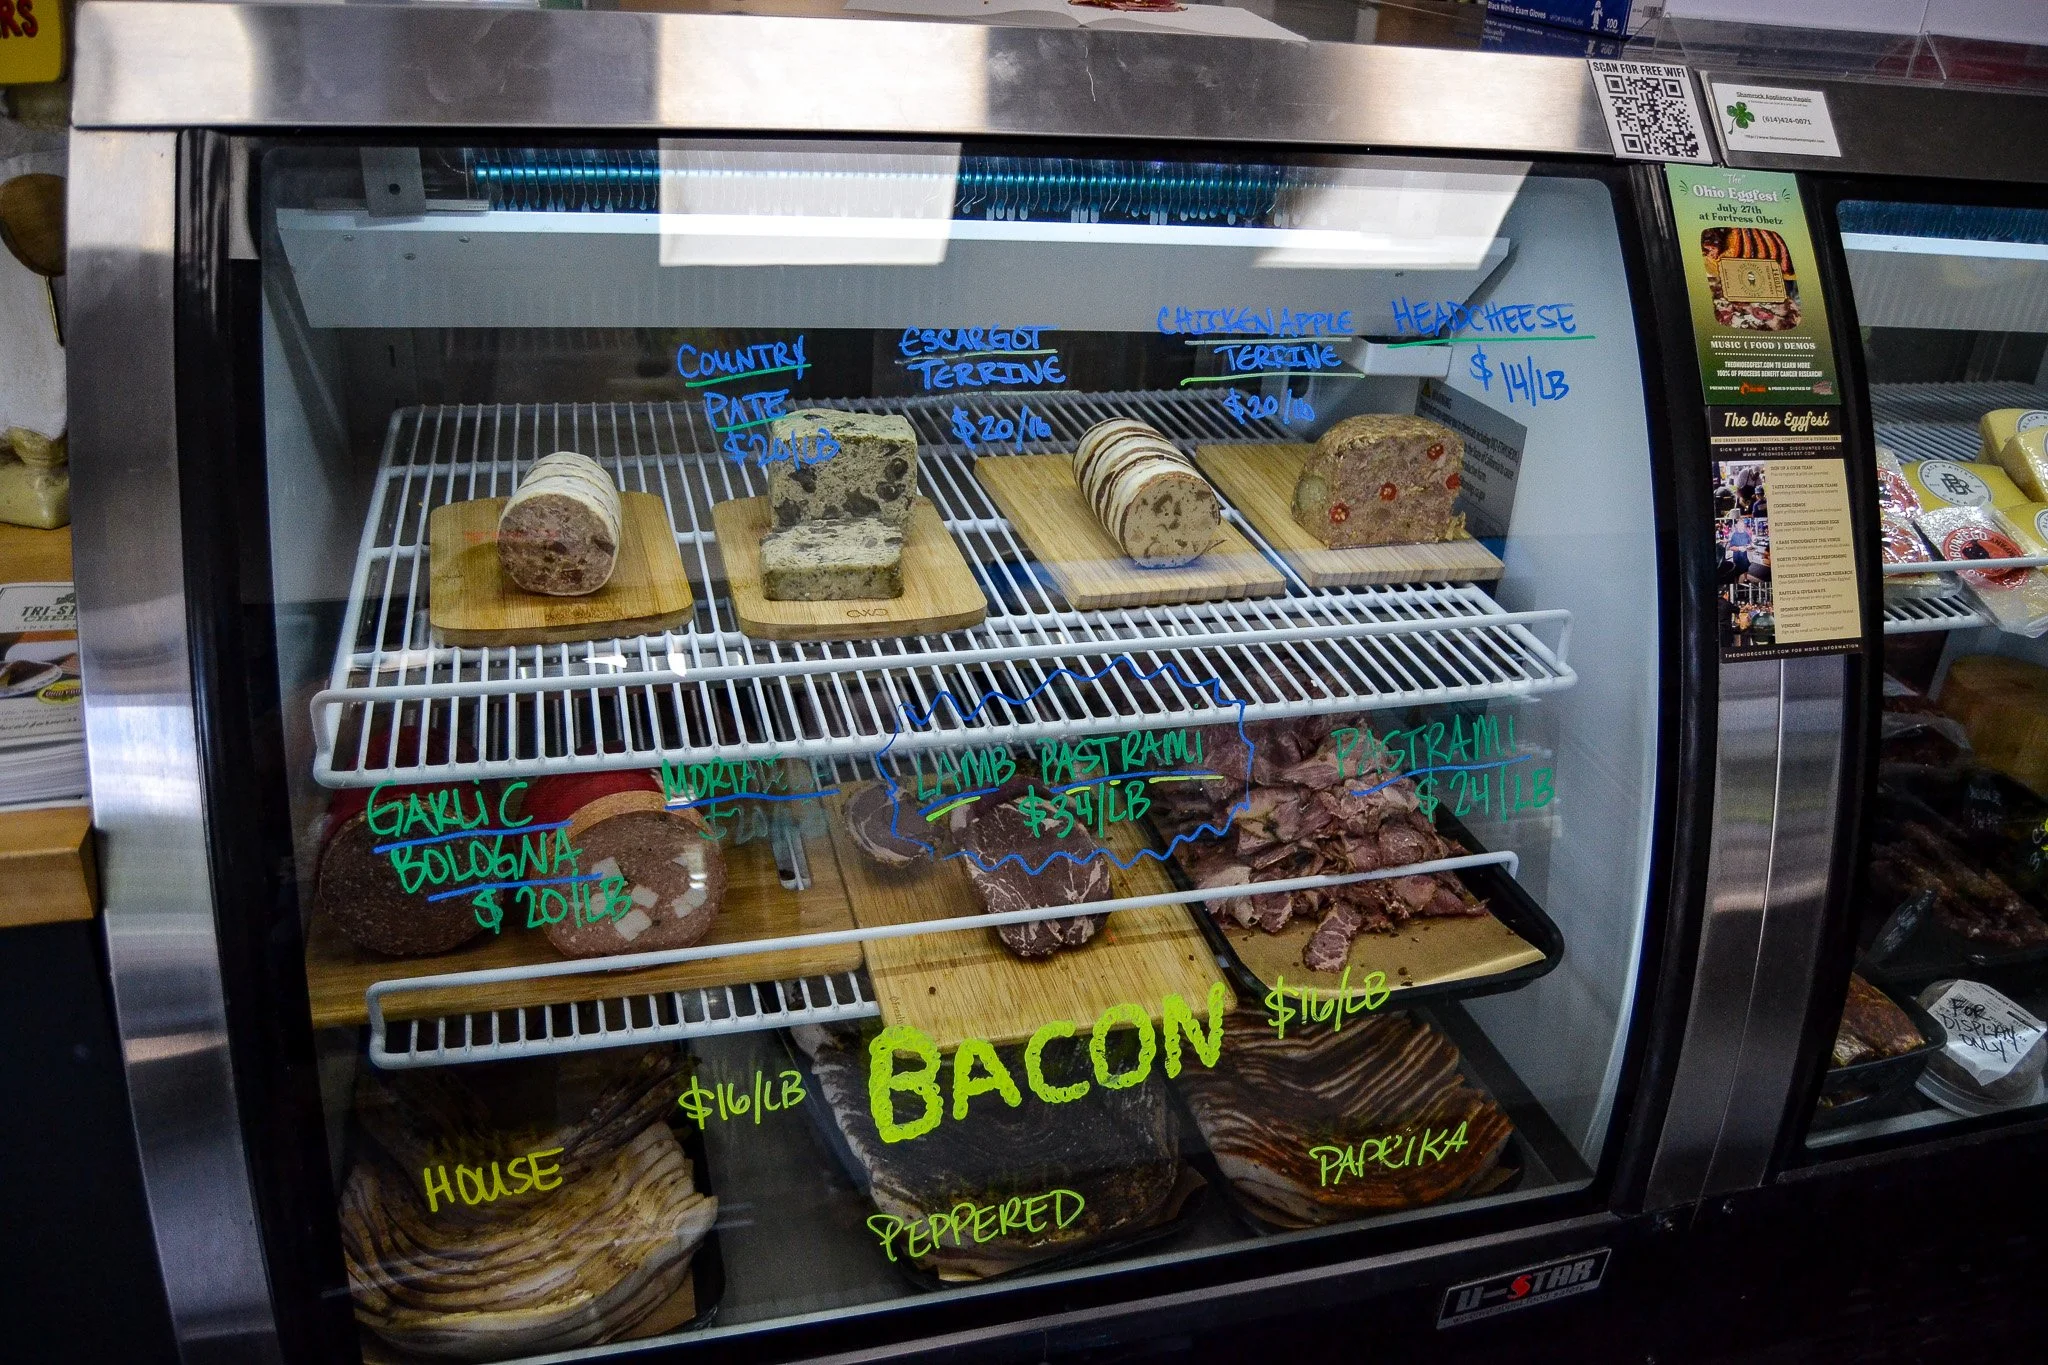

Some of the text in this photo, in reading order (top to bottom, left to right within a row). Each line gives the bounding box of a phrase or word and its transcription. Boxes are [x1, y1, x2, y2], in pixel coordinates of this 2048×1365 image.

[0, 0, 39, 39] RS
[1530, 9, 1547, 20] Gloves
[1606, 18, 1619, 29] 100
[1593, 62, 1686, 79] SCAN FOR FREE WIFI
[1693, 184, 1778, 204] Ohio Eggfest
[1717, 203, 1762, 214] July 27th
[1699, 212, 1784, 225] at Fortress Obetz
[1280, 306, 1355, 335] APPLE
[676, 335, 806, 381] COUNTRY
[899, 324, 1058, 358] ESCARGOT
[1214, 342, 1342, 372] TERRINE
[1710, 340, 1741, 350] MUSIC
[1784, 341, 1816, 350] DEMOS
[908, 354, 1066, 390] TERRINE
[704, 389, 790, 429] PATE
[1724, 410, 1830, 432] The Ohio Eggfest
[21, 605, 76, 617] TRI-ST
[1330, 713, 1517, 779] PASTRAMI
[914, 729, 1204, 801] LAMB PASTRAMI
[387, 829, 584, 894] BOLOGNA
[1949, 998, 1990, 1021] FOR
[1937, 1011, 2020, 1053] DISPLAY
[1959, 1034, 2008, 1064] ONLY
[868, 981, 1227, 1143] BACON
[1309, 1120, 1469, 1187] PAPRIKA
[423, 1147, 564, 1212] HOUSE
[867, 1189, 1085, 1262] PEPPERED
[1455, 1258, 1596, 1313] U-STAR
